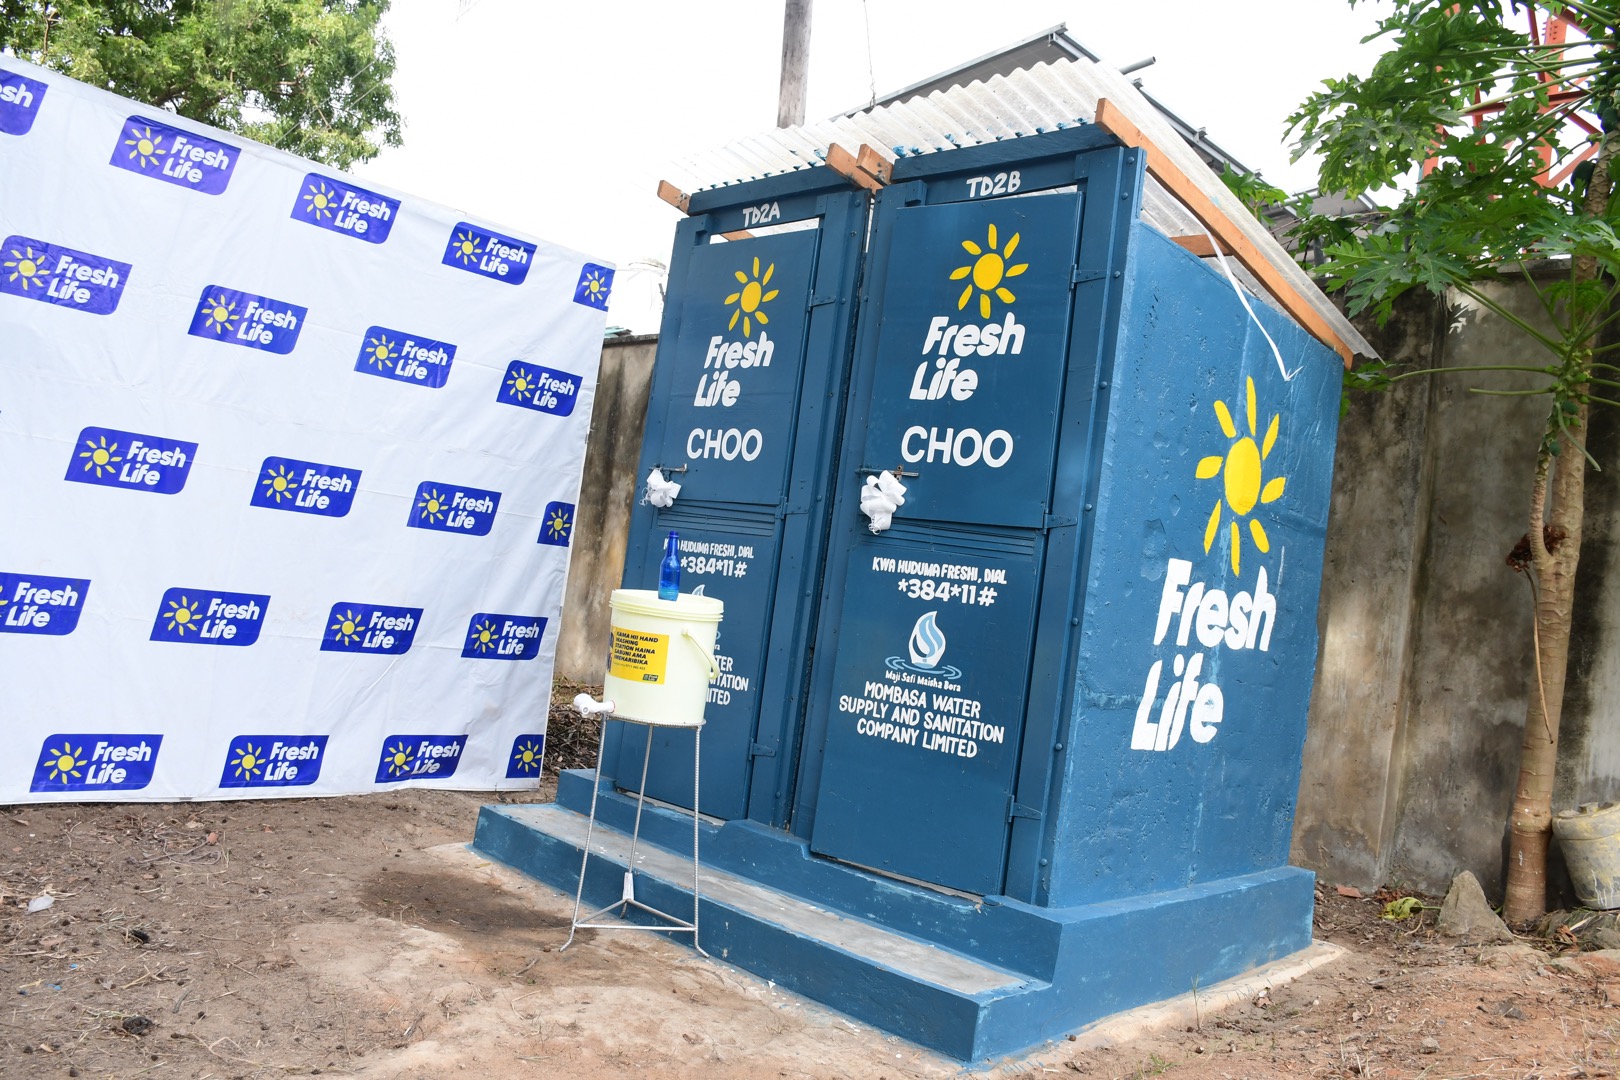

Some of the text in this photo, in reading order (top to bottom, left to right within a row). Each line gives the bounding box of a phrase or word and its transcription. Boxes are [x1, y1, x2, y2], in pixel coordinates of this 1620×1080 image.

[170, 136, 230, 171] Fresh
[162, 157, 203, 183] Life
[966, 170, 1021, 198] TD2B
[340, 190, 391, 221] Fresh
[742, 202, 781, 228] TD2A
[334, 210, 368, 233] Life
[485, 237, 528, 264] Fresh
[55, 255, 120, 289] Fresh
[479, 255, 509, 276] Life
[46, 277, 91, 304] Life
[243, 300, 297, 330] Fresh
[236, 321, 273, 345] Life
[921, 311, 1026, 357] Fresh
[401, 340, 448, 366] Fresh
[703, 330, 775, 369] Fresh
[394, 359, 428, 380] Life
[909, 357, 979, 401] Life
[538, 372, 575, 396] Fresh
[693, 370, 741, 407] Life
[532, 390, 558, 409] Life
[126, 440, 187, 468] Fresh
[686, 427, 763, 462] CHOO
[901, 425, 1014, 468] CHOO
[118, 463, 161, 486] Life
[301, 468, 352, 493] Fresh
[295, 489, 330, 509] Life
[451, 492, 494, 514] Fresh
[446, 510, 475, 529] Life
[679, 539, 710, 555] HUDUMA
[737, 545, 754, 559] DIAL
[872, 556, 1008, 585] KWA HUDUMA FRESHI, DIAL
[13, 582, 79, 607] Fresh
[1153, 558, 1277, 652] Fresh
[5, 605, 50, 628] Life
[206, 598, 260, 620] Fresh
[368, 611, 414, 631] Fresh
[200, 619, 237, 639] Life
[362, 630, 395, 649] Life
[502, 621, 539, 638] Fresh
[497, 638, 524, 655] Life
[712, 654, 734, 672] TER
[885, 669, 961, 692] Maji Safi Maisha Bora
[706, 687, 731, 706] ITED
[863, 680, 981, 719] MOMBASA WATER
[1130, 652, 1224, 752] Life
[838, 694, 1005, 744] SUPPLY AND SANITATION
[417, 741, 460, 758] Fresh
[856, 717, 978, 758] COMPANY LIMITED
[91, 741, 152, 762] Fresh
[269, 741, 319, 760] Fresh
[85, 763, 127, 785] Life
[263, 761, 298, 781] Life
[411, 760, 440, 775] Life
